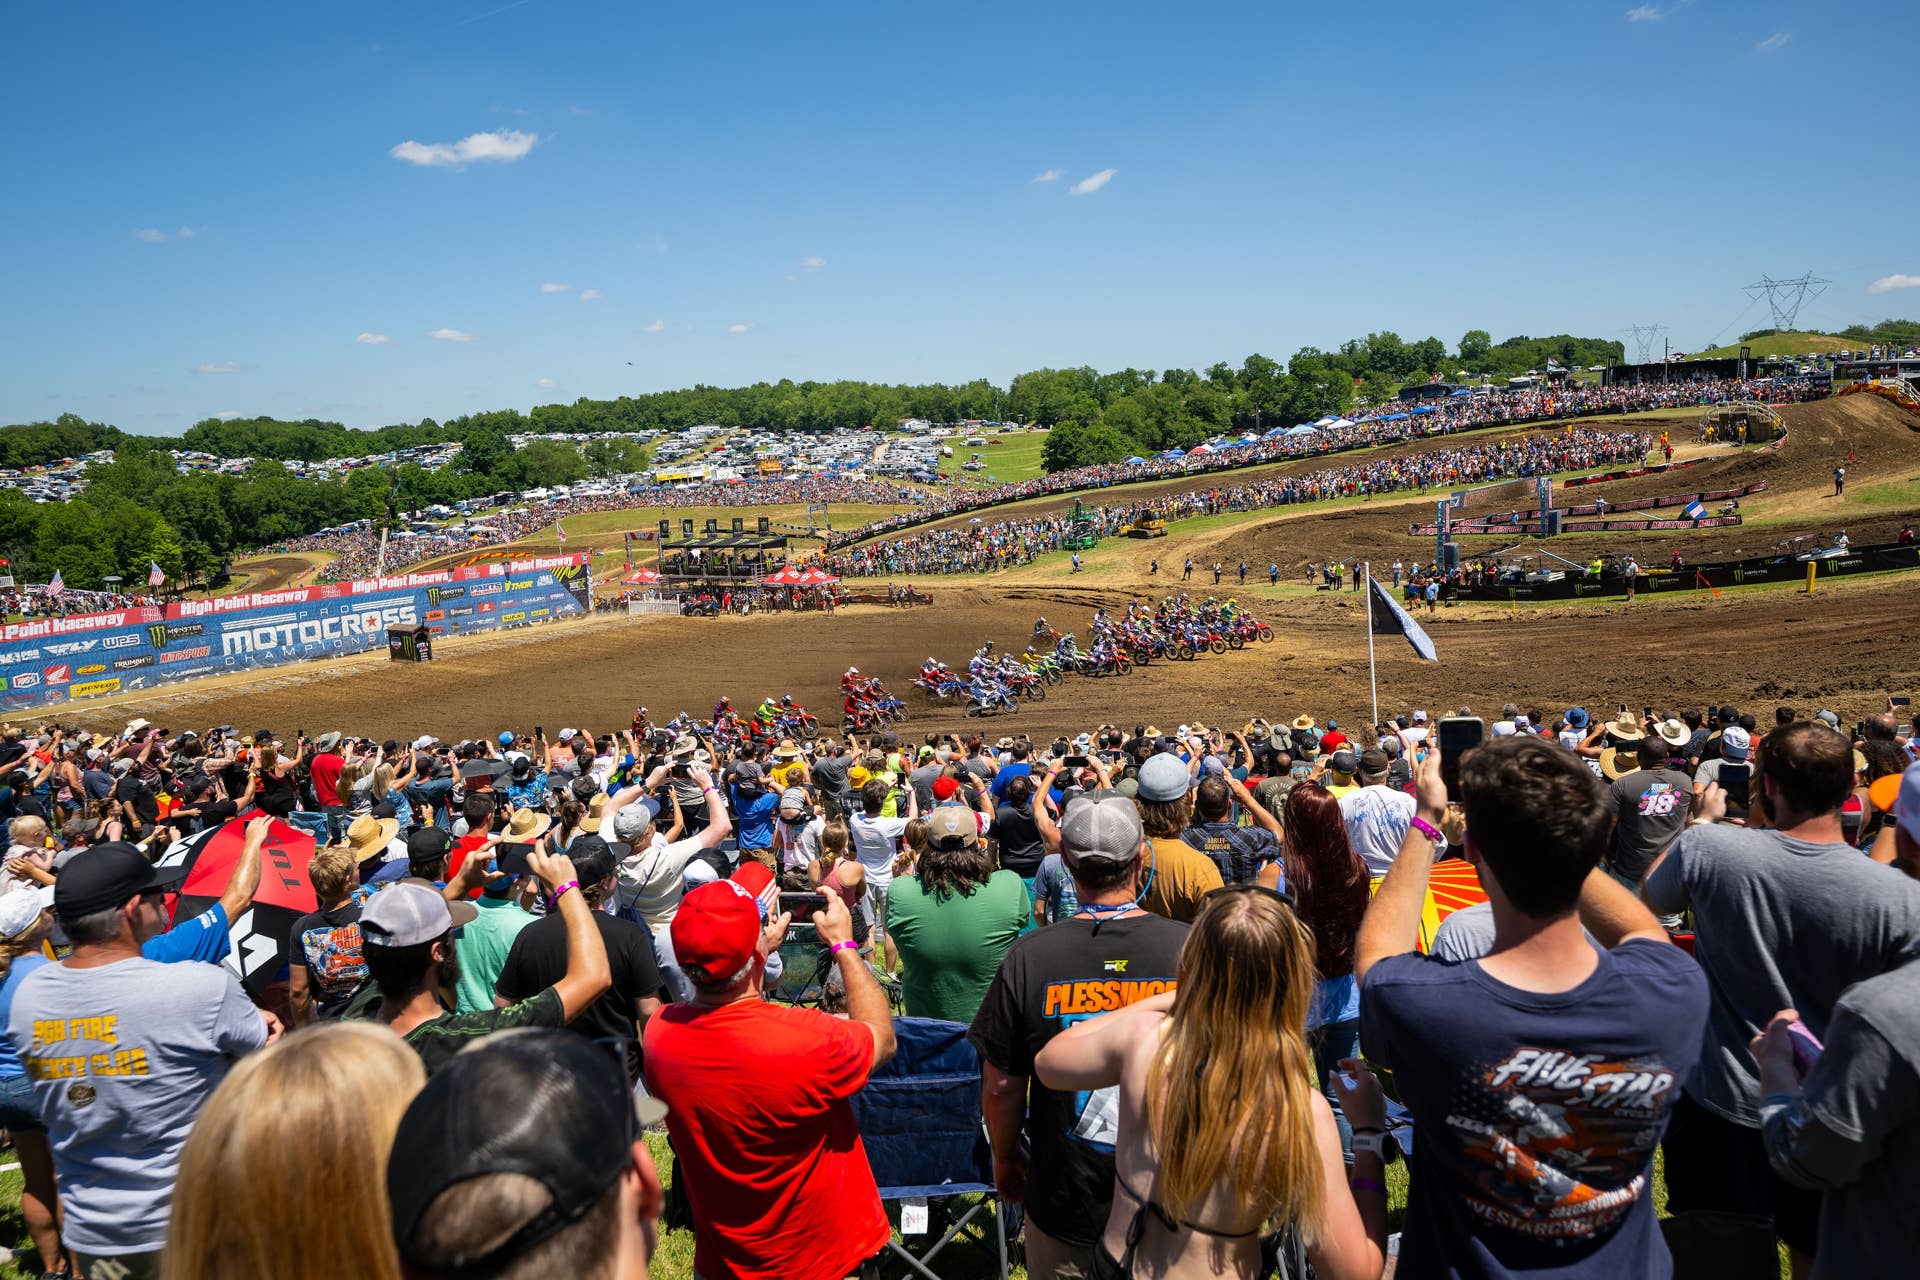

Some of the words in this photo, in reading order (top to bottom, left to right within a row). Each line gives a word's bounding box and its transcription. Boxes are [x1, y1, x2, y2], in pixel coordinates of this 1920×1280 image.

[511, 559, 535, 572] Point
[535, 556, 574, 568] Raceway
[352, 577, 378, 592] High
[378, 575, 408, 590] Point
[408, 571, 454, 588] Raceway
[471, 582, 502, 592] PARTS
[511, 580, 533, 591] THOR
[181, 598, 213, 616] High
[214, 594, 251, 612] Point
[251, 589, 309, 608] Raceway
[300, 604, 349, 620] PRO
[5, 620, 51, 640] Point
[53, 613, 126, 632] Raceway
[167, 624, 202, 635] MONSTER
[222, 605, 417, 657] MOTOCROSS
[43, 639, 99, 654] FLY
[103, 634, 140, 649] WPS
[113, 655, 152, 668] TRIUMPH
[160, 646, 210, 663] MOTOSPORT
[80, 680, 118, 692] DUNLOP
[1645, 794, 1675, 815] 18
[69, 1014, 118, 1045] FIRE
[91, 1047, 149, 1076] CLUB
[1491, 1050, 1605, 1087] FIVE
[1564, 1072, 1674, 1109] STAR
